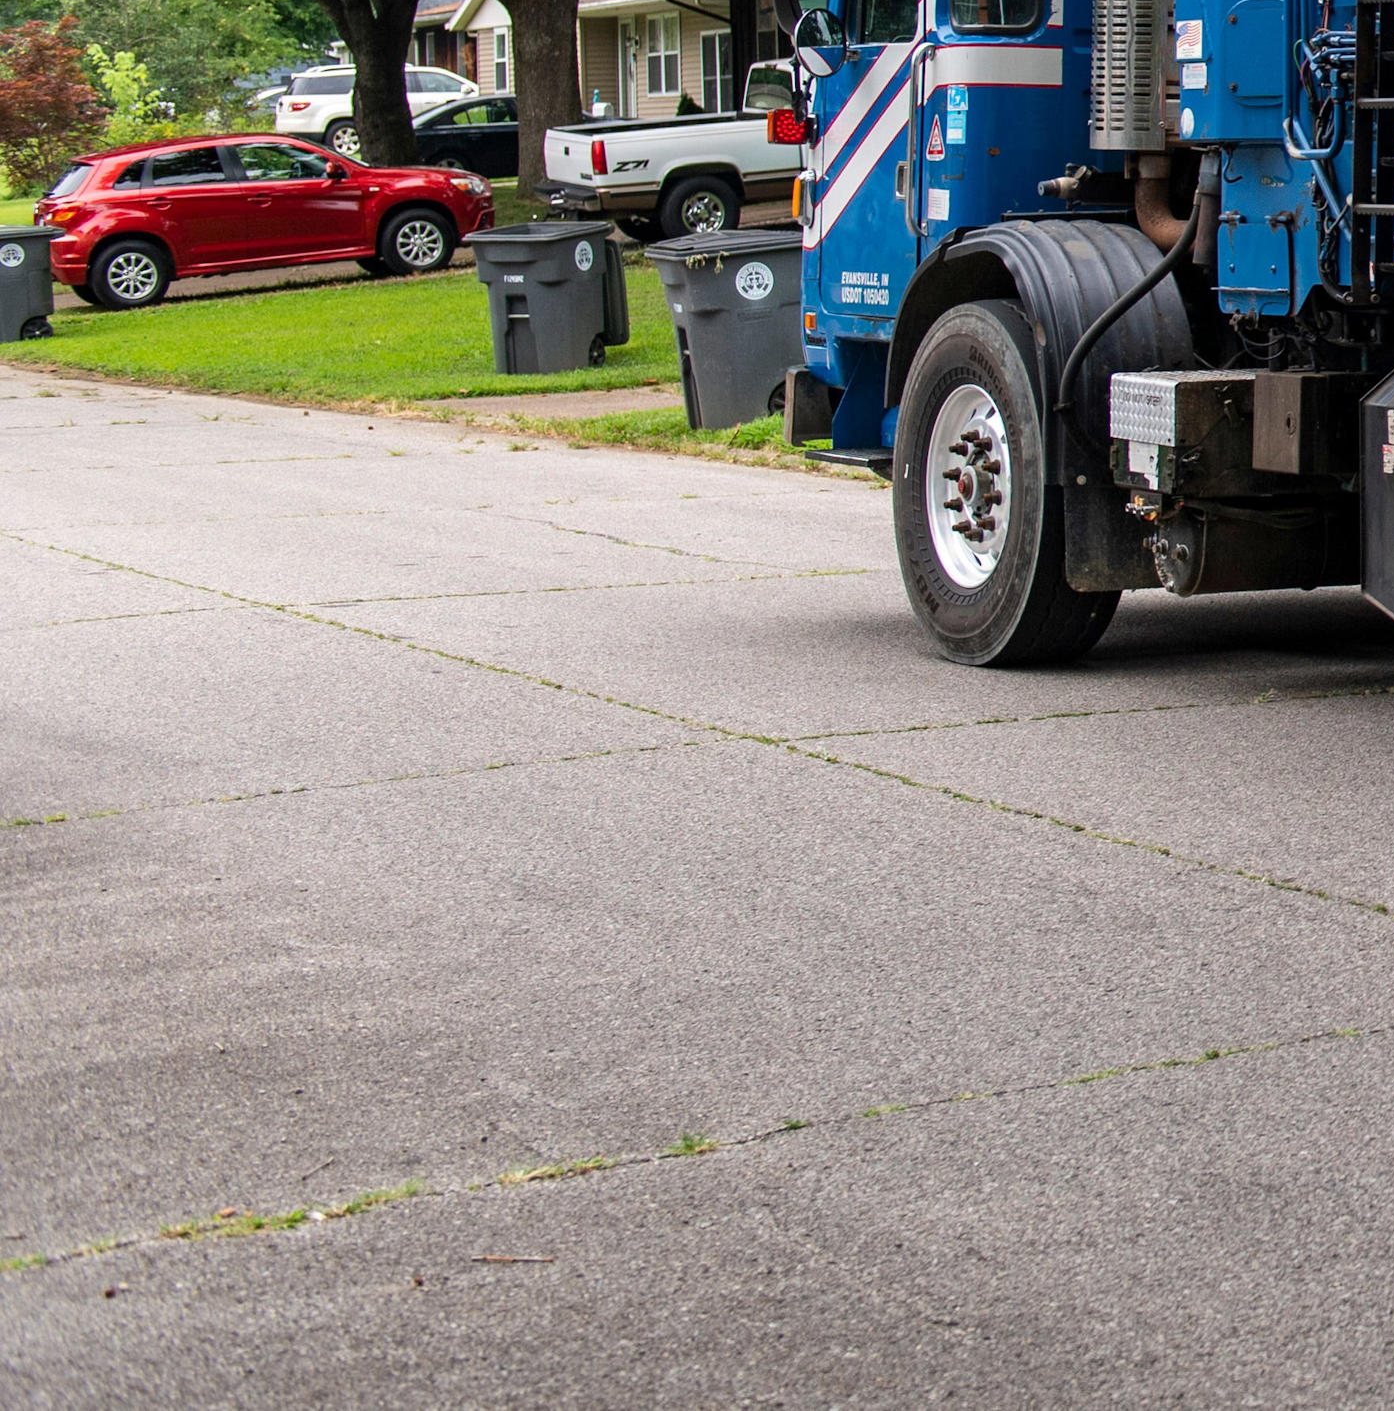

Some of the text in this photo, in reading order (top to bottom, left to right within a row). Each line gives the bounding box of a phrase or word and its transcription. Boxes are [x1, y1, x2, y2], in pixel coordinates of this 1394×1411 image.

[612, 159, 650, 173] Z71
[841, 271, 889, 288] EVANSVILLE, IN
[841, 286, 862, 303] USDOT
